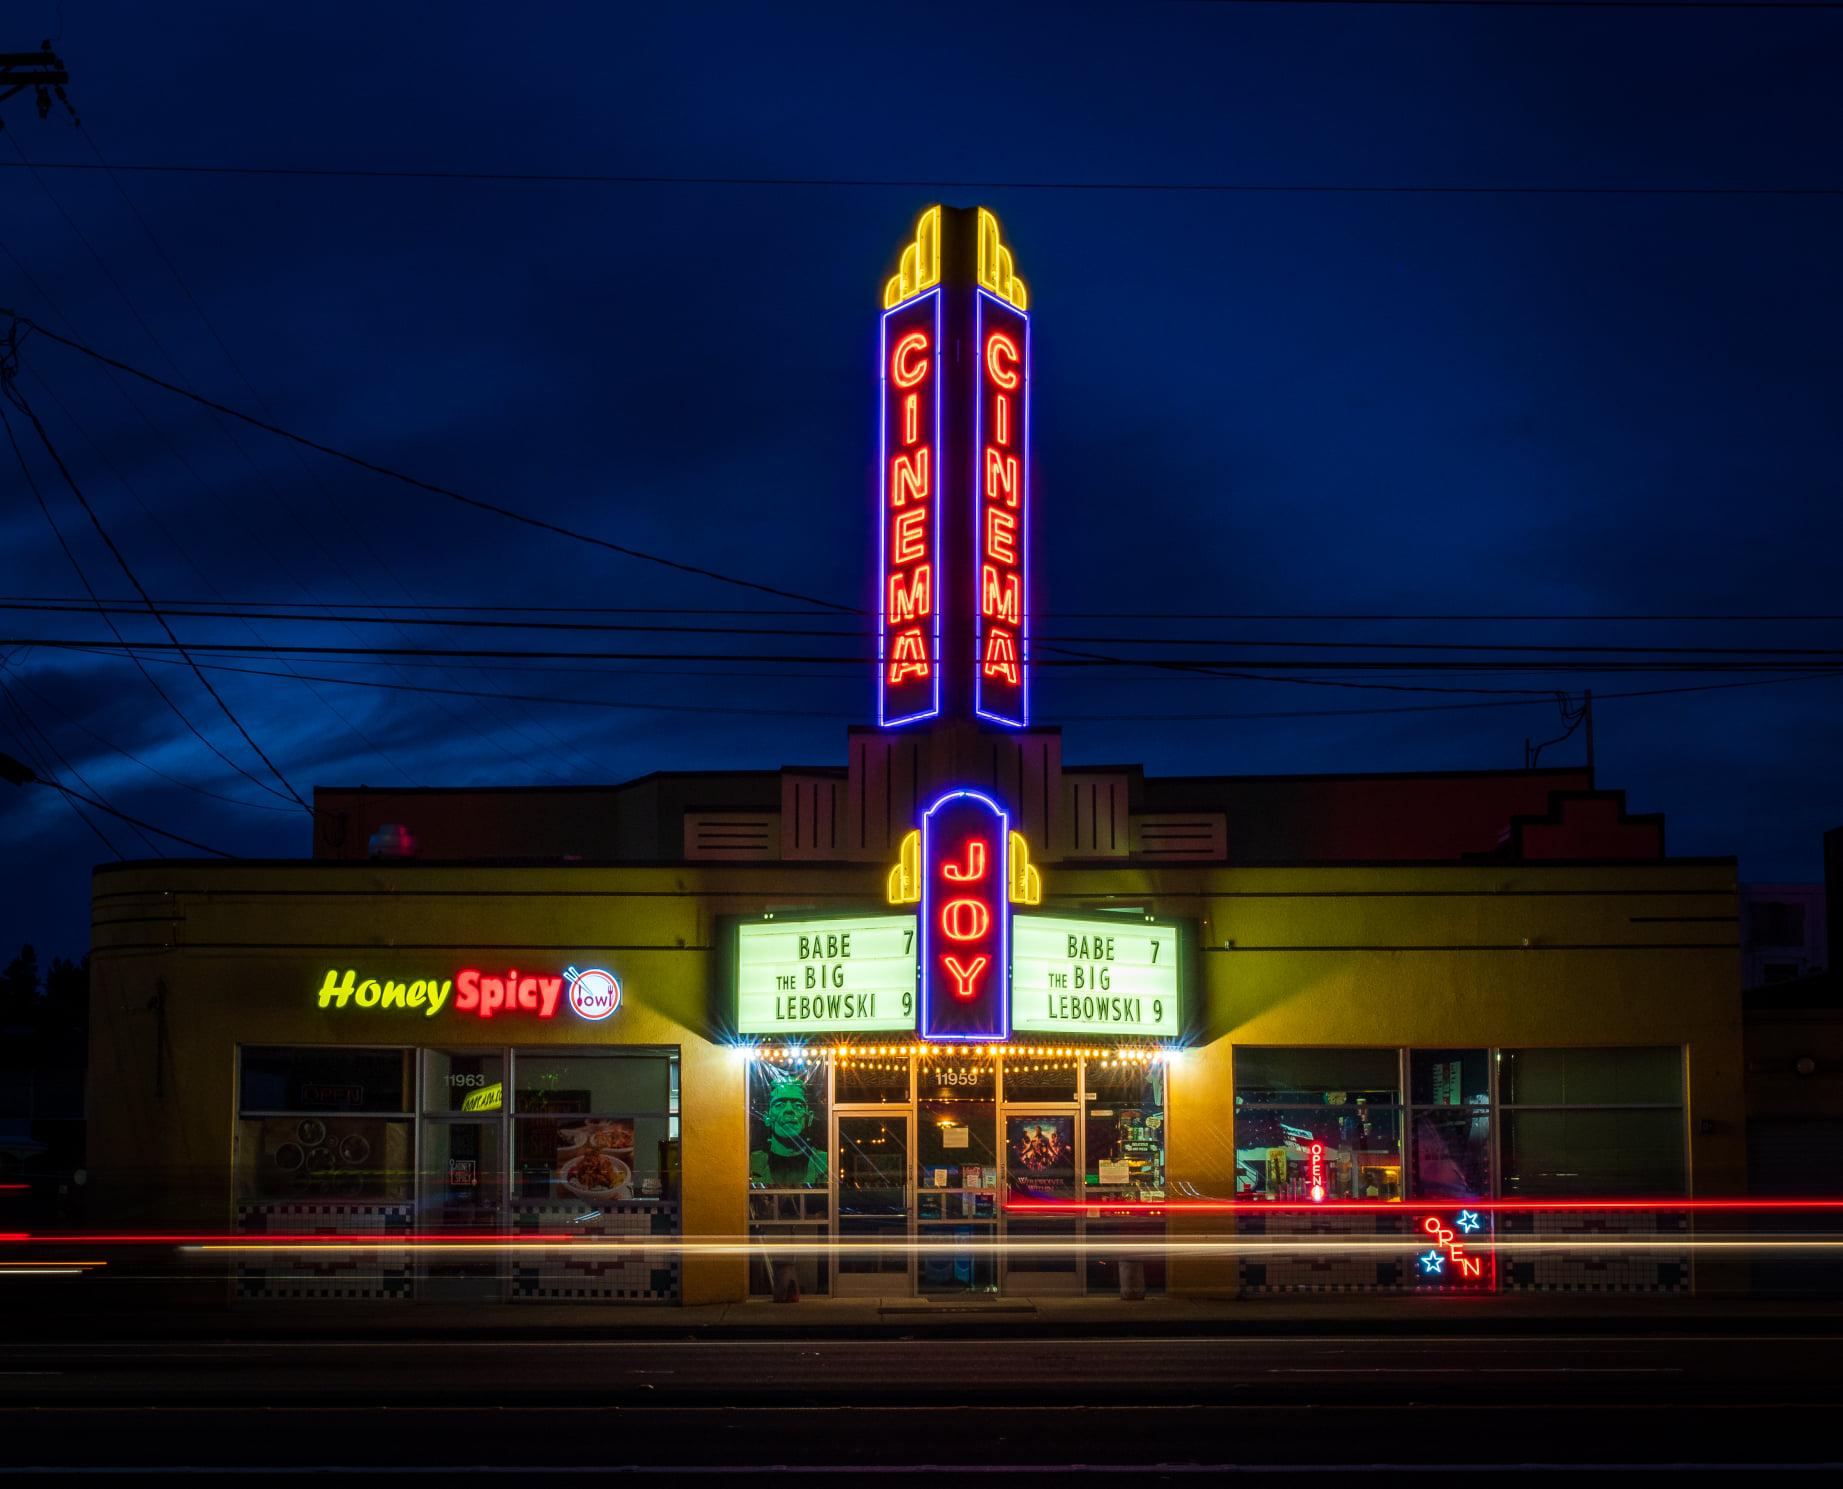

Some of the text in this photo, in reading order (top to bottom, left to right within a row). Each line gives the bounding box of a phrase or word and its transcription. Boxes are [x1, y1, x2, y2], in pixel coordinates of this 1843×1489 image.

[888, 333, 931, 684] CINEMA
[982, 333, 1019, 684] CINEMA
[943, 842, 988, 995] JOY
[799, 930, 914, 959] BABE 7
[1067, 933, 1160, 964] BABE 7
[776, 964, 844, 990] THE BIG
[1048, 965, 1110, 990] THE BIG
[318, 969, 452, 1017] Honey
[455, 968, 563, 1017] Spicy
[776, 992, 913, 1020] LEBOWSKI 9
[1048, 994, 1163, 1023] LEBOWSKI 9
[442, 1074, 485, 1087] 11963
[936, 1072, 978, 1086] 11959
[1311, 1144, 1322, 1186] OPEN
[1425, 1217, 1480, 1276] OPEN
